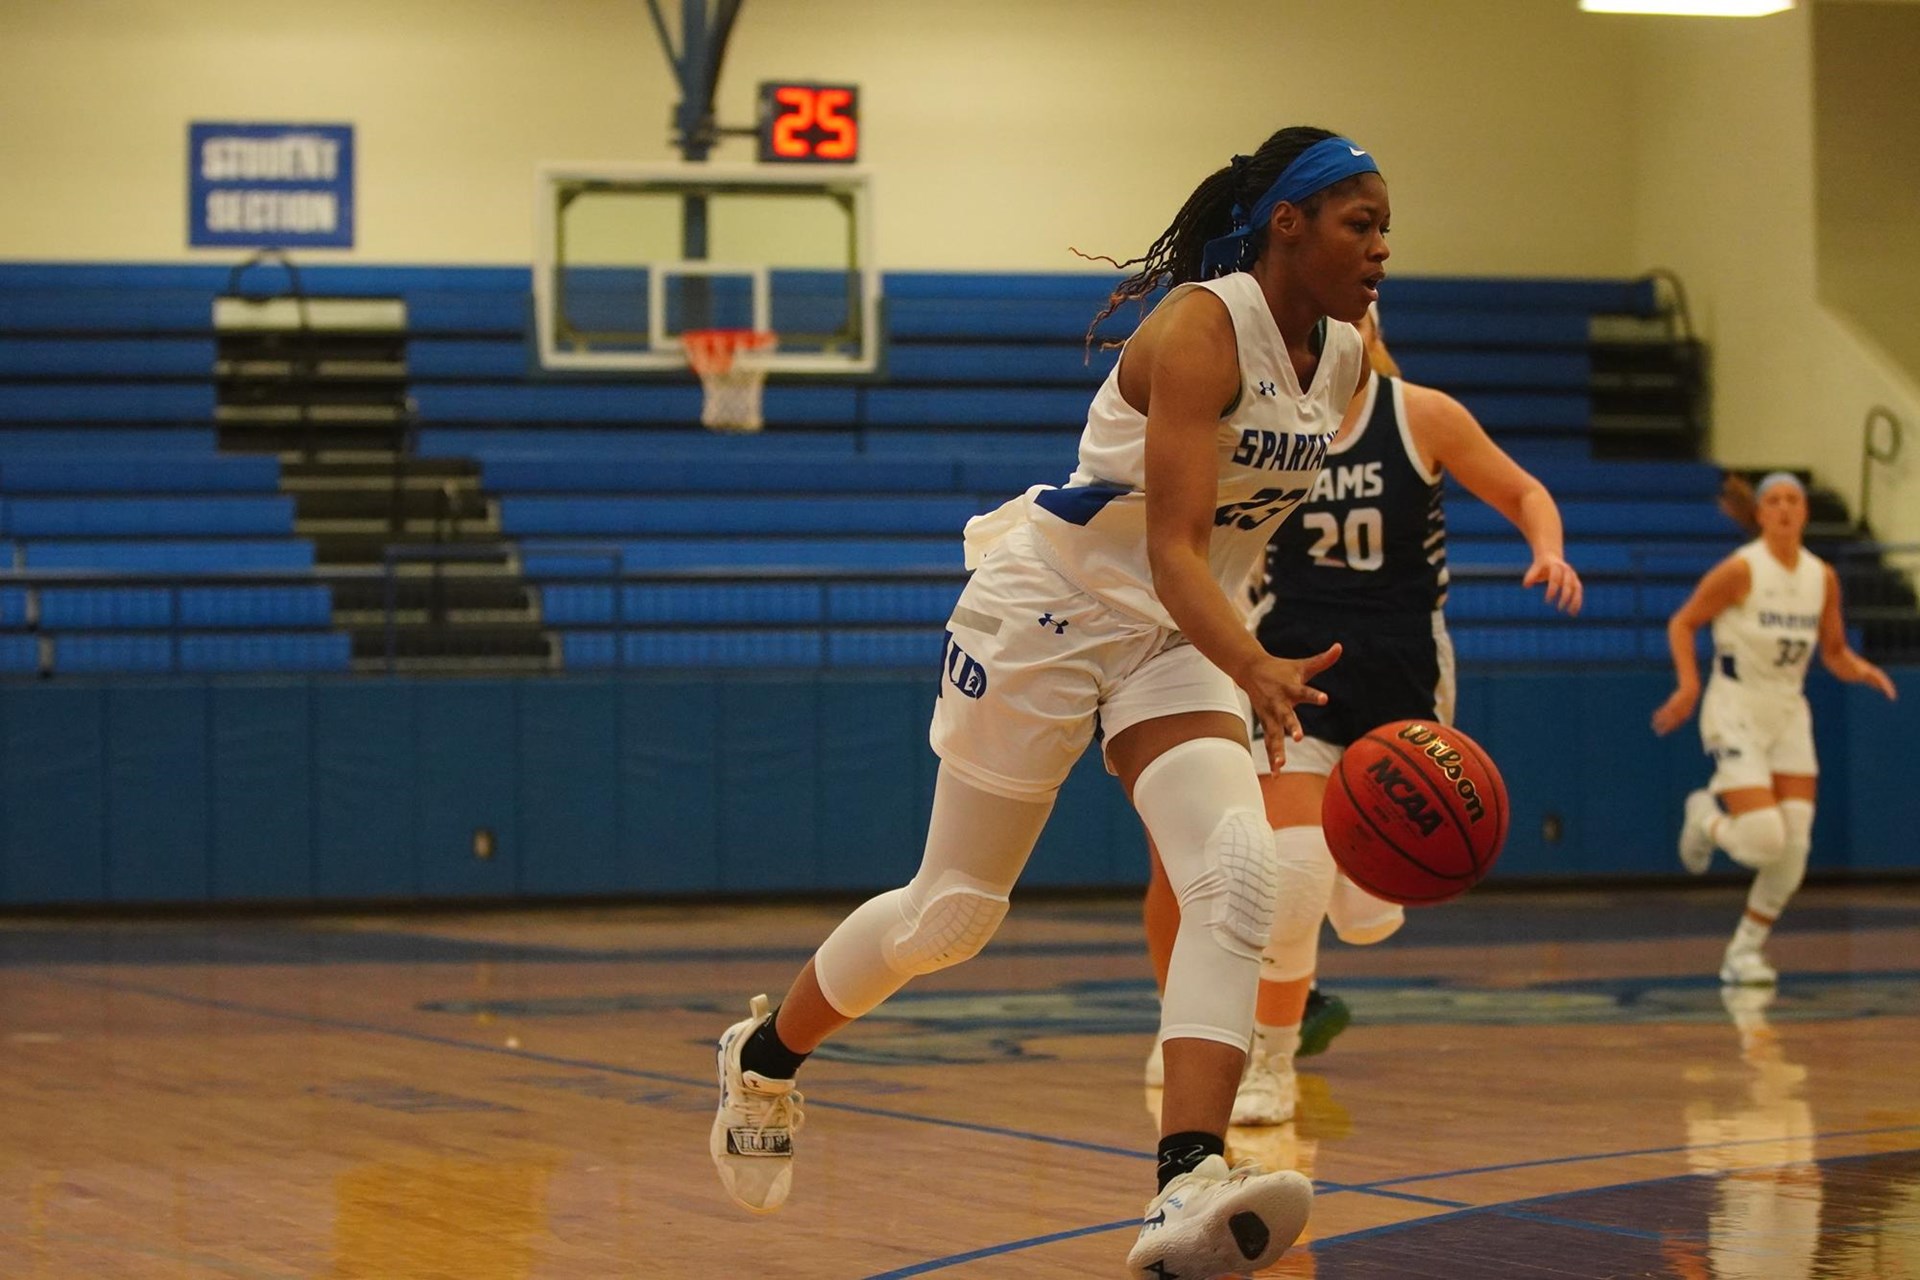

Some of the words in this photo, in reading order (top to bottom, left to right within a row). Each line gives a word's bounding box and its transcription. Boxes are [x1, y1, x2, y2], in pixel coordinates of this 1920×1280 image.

[773, 86, 858, 159] 25
[206, 190, 337, 234] SECTION
[1231, 428, 1337, 472] SPARTA
[1304, 462, 1383, 503] AMS
[1303, 508, 1383, 571] 20
[1367, 755, 1443, 837] NCAA
[1397, 723, 1485, 825] Wilson
